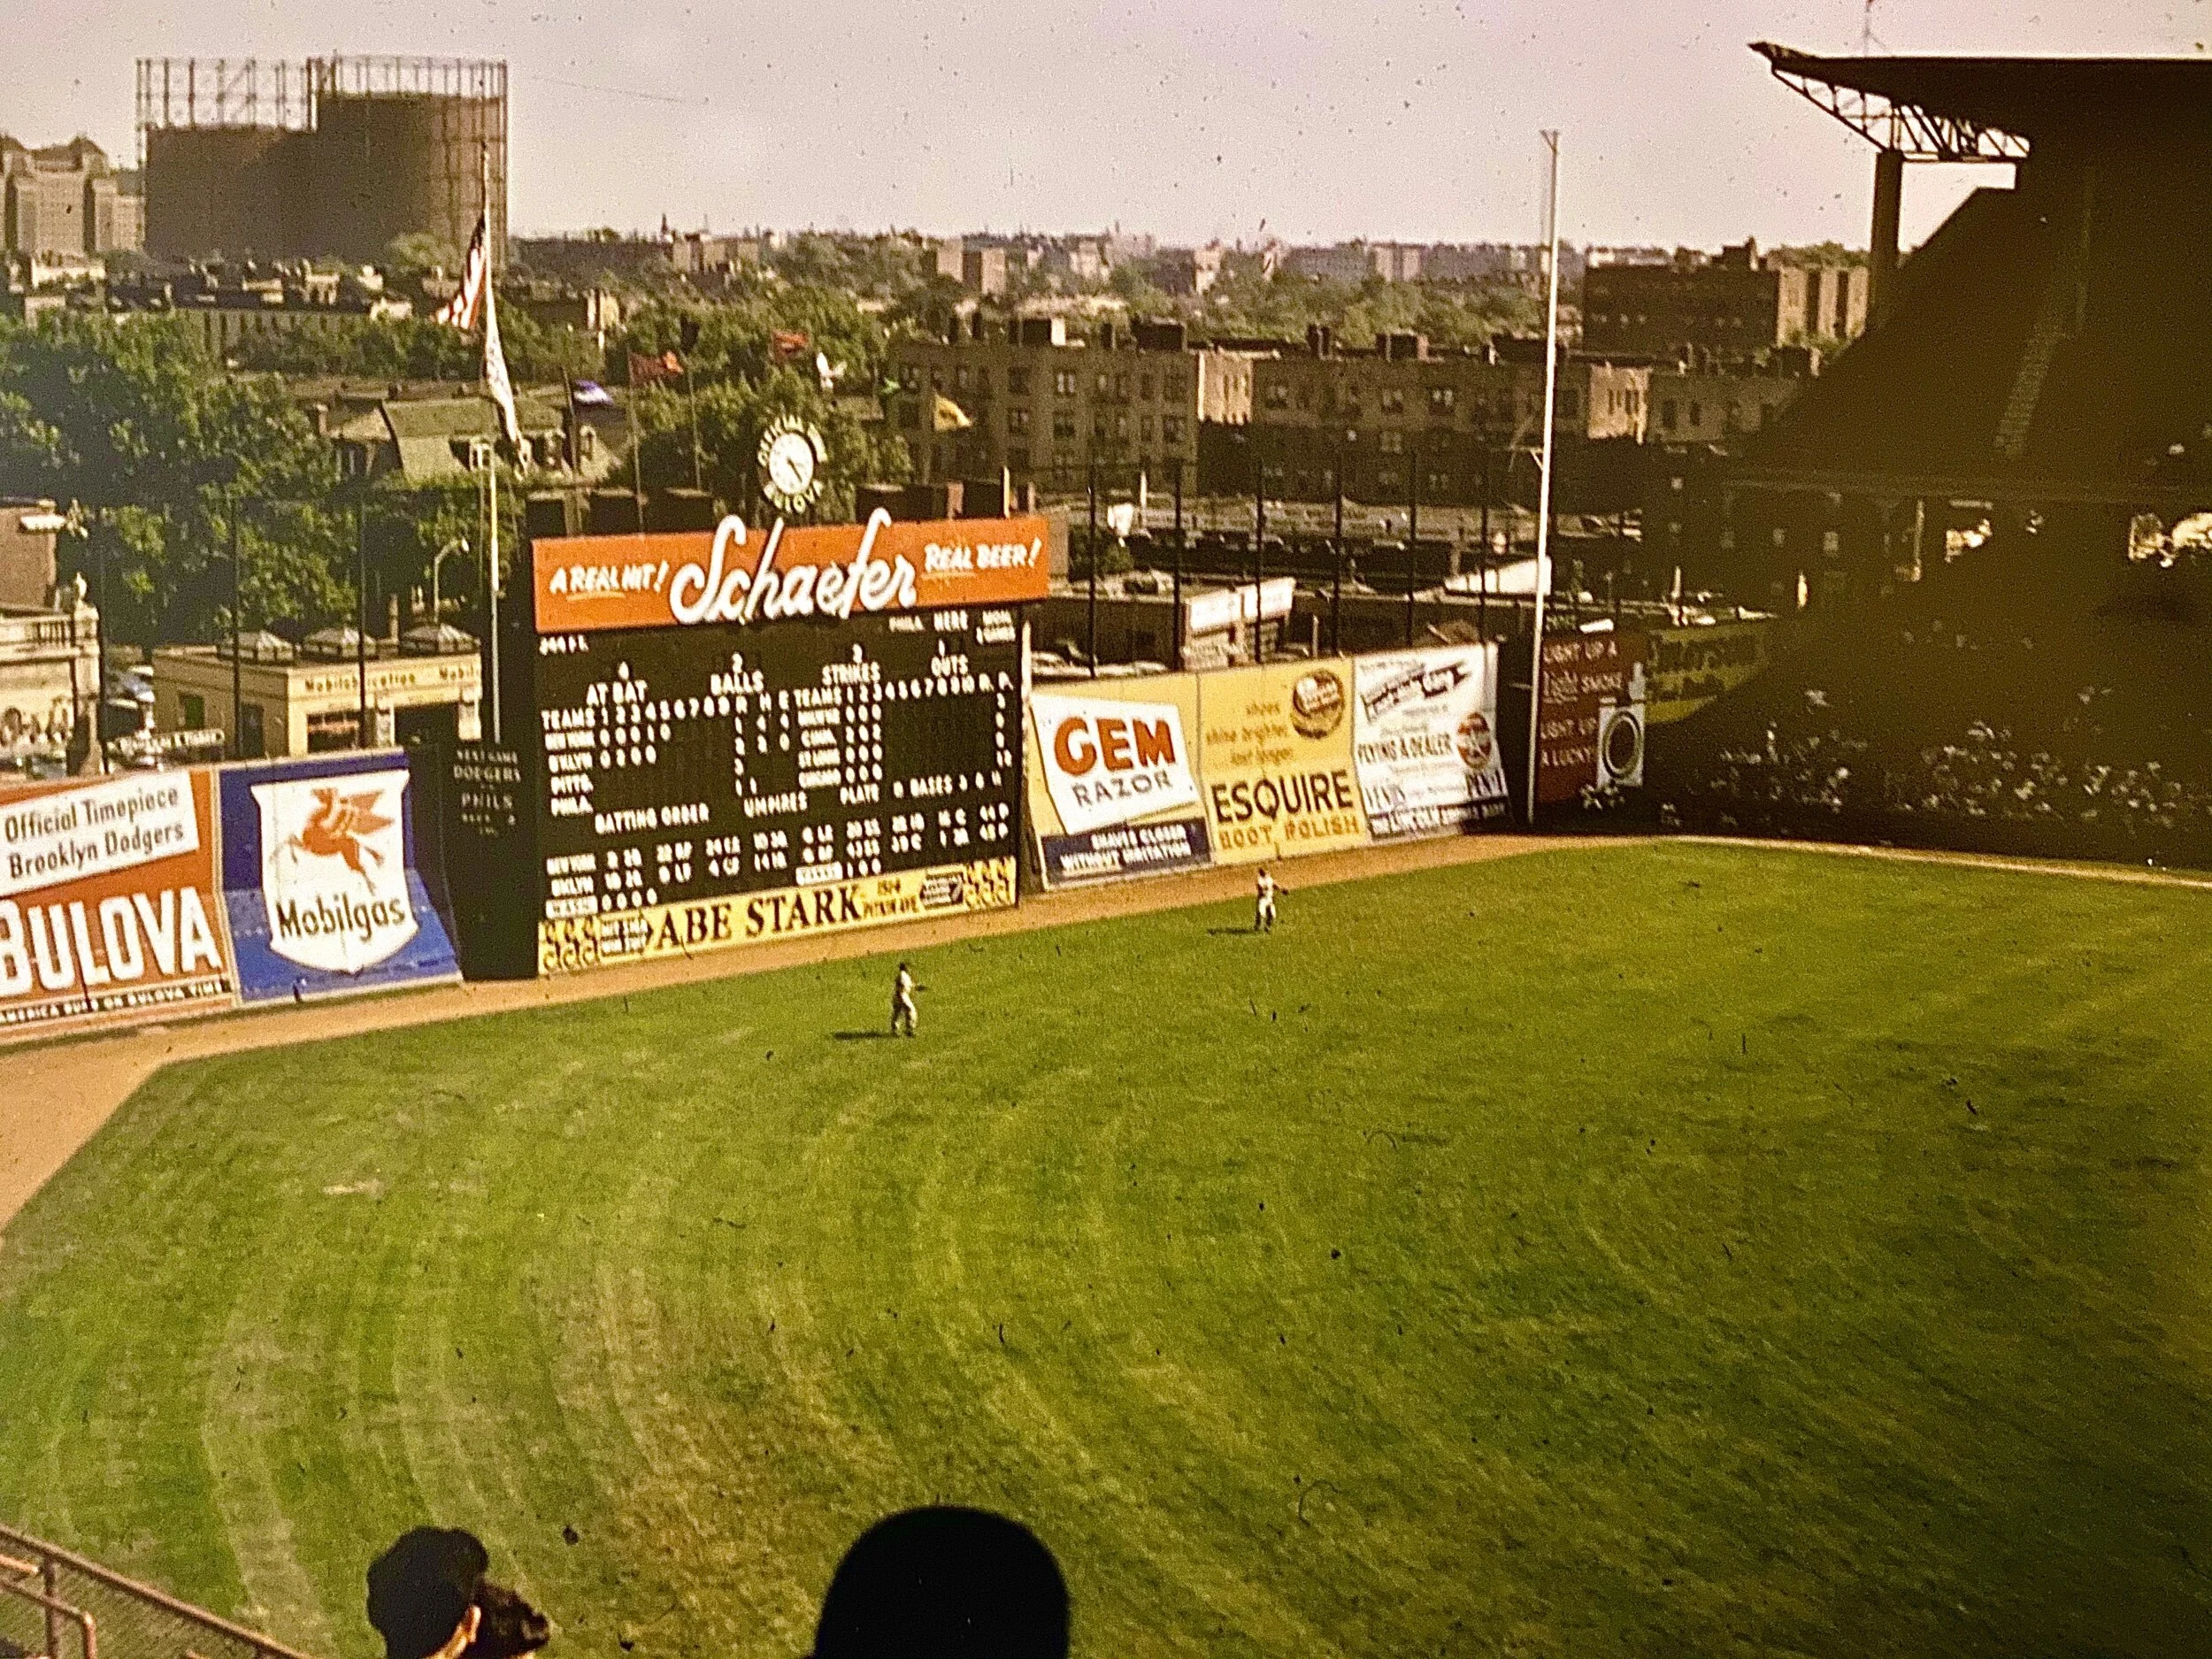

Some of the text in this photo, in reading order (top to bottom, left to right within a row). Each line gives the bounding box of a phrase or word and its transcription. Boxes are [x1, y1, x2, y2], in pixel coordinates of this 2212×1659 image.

[670, 507, 918, 626] Schaefer
[924, 537, 1041, 571] REAL BEER!
[549, 566, 566, 594] A
[567, 565, 622, 592] REAL
[1584, 640, 1605, 662] UP
[1607, 639, 1618, 657] A
[822, 661, 880, 687] STRIKES
[931, 654, 969, 678] OUTS
[585, 680, 648, 708] AT BAT
[710, 670, 764, 696] BALLS
[794, 685, 842, 710] TEAMS
[541, 707, 595, 731] TEAMS
[1540, 717, 1598, 741] LIGHT UP
[1054, 716, 1176, 777] GEM
[1552, 747, 1592, 767] LUCKY
[453, 764, 521, 784] DODGERS
[910, 775, 953, 797] BASES
[841, 783, 879, 805] PLATE
[1071, 771, 1174, 808] RAZOR
[1210, 768, 1354, 823] ESQUIRE
[4, 785, 178, 843] Official Timepiece
[595, 803, 709, 834] BATTING ORDER
[743, 791, 808, 818] UMPIRES
[1218, 824, 1274, 851] BOOT
[1284, 816, 1360, 841] POLISH
[7, 822, 184, 881] Brooklyn Dodgers
[1059, 849, 1123, 871] WITHOUT
[274, 892, 406, 941] Mobilgas
[657, 903, 732, 951] ABE
[745, 883, 860, 939] STARK
[0, 885, 223, 997] BULOVA
